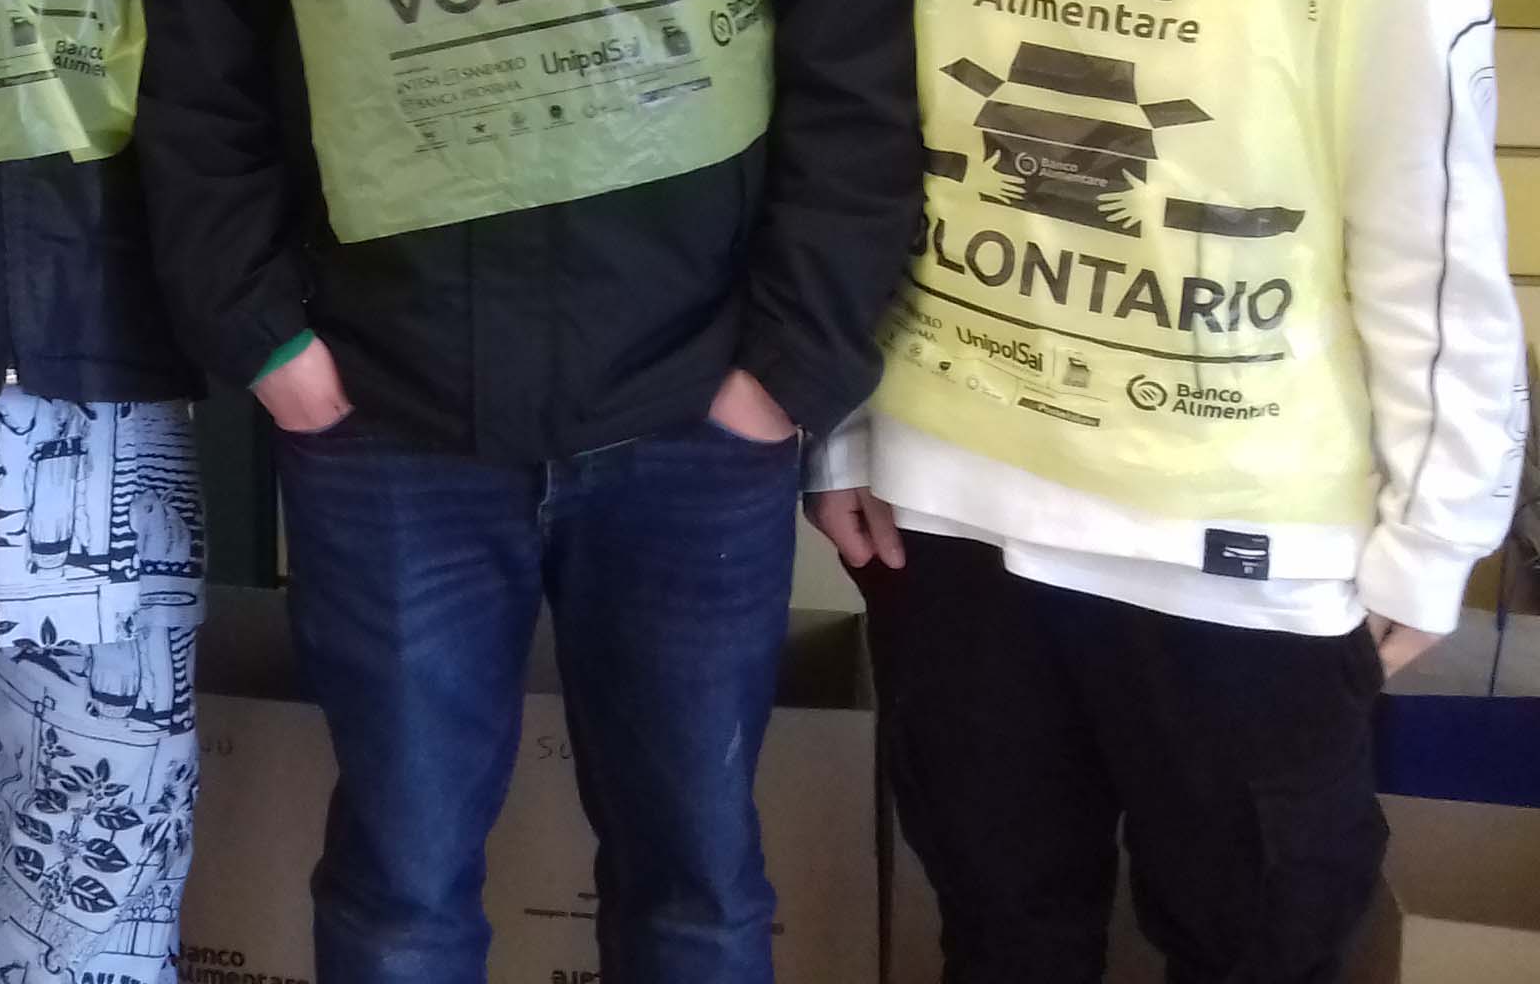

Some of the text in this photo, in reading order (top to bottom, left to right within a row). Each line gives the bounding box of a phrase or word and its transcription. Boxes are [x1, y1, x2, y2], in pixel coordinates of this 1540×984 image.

[955, 325, 1044, 373] UnipolSai
[1176, 383, 1243, 404] Banco
[178, 944, 245, 967] anco
